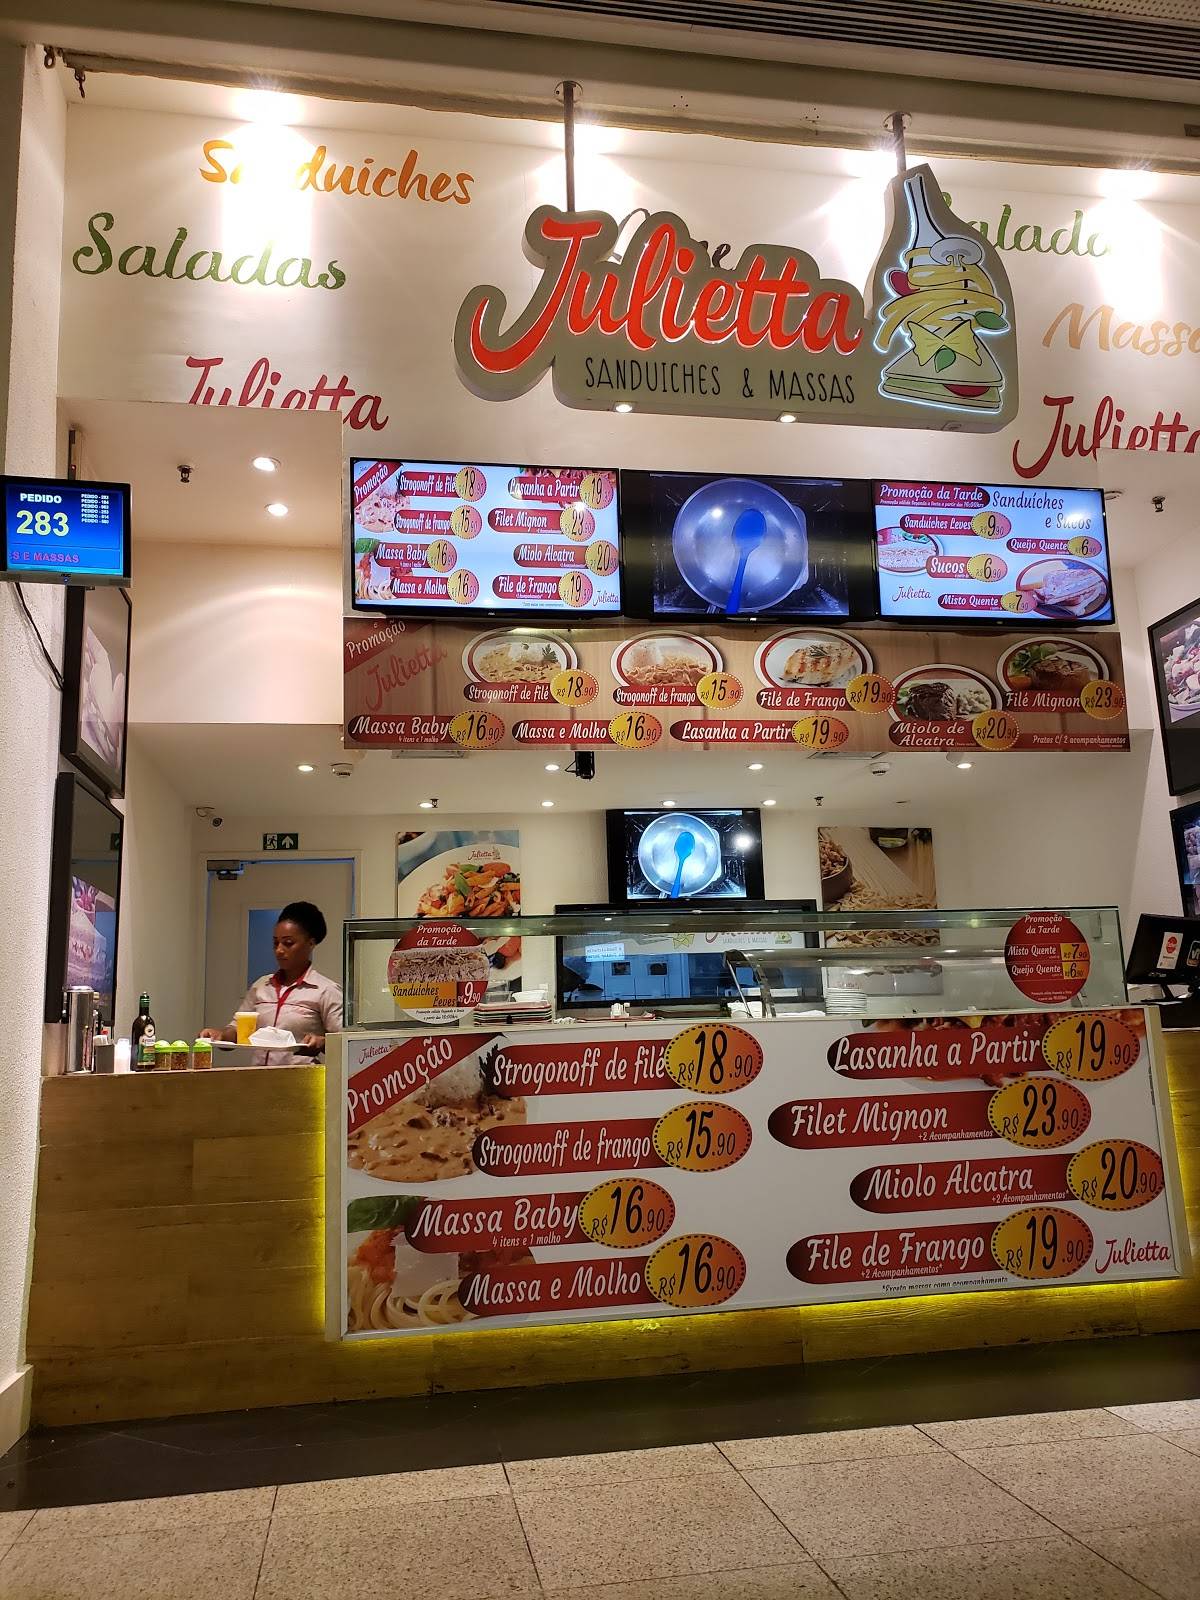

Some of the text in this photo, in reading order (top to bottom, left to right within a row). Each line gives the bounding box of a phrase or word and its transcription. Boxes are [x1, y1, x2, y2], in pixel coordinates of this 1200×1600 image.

[199, 139, 475, 205] Sduiches
[72, 211, 347, 291] Saladas
[470, 216, 863, 375] Julietta
[585, 357, 856, 404] SANDUICHES & MASSAS
[354, 463, 389, 503] Promoção
[399, 475, 433, 496] Strogonoff
[436, 475, 443, 492] de
[509, 477, 580, 498] Lasanha a Partir
[880, 484, 983, 502] Promoção da Tarde
[20, 493, 62, 504] PEDIDO
[992, 490, 1065, 510] Sanduíches
[16, 510, 69, 537] 283
[395, 513, 425, 534] Strogonoff
[426, 514, 432, 529] de
[494, 510, 548, 532] Filet Mignon
[904, 515, 972, 530] Sanduíches Leves
[1045, 512, 1092, 530] e Sucos
[375, 543, 428, 566] Massa Baby
[517, 544, 575, 562] Miolo Alcatra
[1010, 538, 1068, 553] Queijo Quente
[34, 553, 79, 563] MASSAS
[930, 557, 965, 574] Sucos
[391, 577, 447, 595] Massa e Molho
[515, 575, 526, 593] de
[527, 577, 558, 598] Frango
[892, 585, 932, 602] Julietta
[592, 590, 619, 607] Julietta
[940, 594, 999, 607] Misto Quente
[345, 618, 406, 660] Promoção
[468, 684, 549, 704] Strogonoff de filé
[615, 686, 696, 707] Strogonoff de frango
[759, 689, 846, 712] Filé de Frango
[1005, 691, 1081, 713] Filé Mignon
[352, 715, 450, 741] Massa Baby
[515, 721, 607, 739] Massa e Molho
[682, 721, 791, 741] Lasanha a Partir
[893, 721, 965, 734] Miolo de
[898, 735, 955, 747] Alcatra
[1032, 734, 1054, 745] Pratos
[1069, 735, 1127, 746] acompanhamentos
[416, 924, 462, 935] Promoção
[1024, 914, 1063, 924] Promoção
[1026, 925, 1060, 934] da Tarde
[417, 936, 458, 946] da Tarde
[1007, 945, 1057, 957] Misto Quente
[1011, 964, 1061, 976] Queijo Quente
[432, 996, 456, 1008] Leves
[358, 1046, 389, 1065] Julietta
[833, 1029, 1041, 1072] Lasanha a Partir
[1055, 1019, 1131, 1073] R$19.90
[676, 1029, 754, 1086] R$18.90
[347, 1036, 453, 1124] Promoção
[493, 1045, 665, 1095] Strogonoff de filé
[791, 1101, 948, 1141] Filet Mignon
[1001, 1083, 1080, 1138] R$23.90
[665, 1109, 737, 1163] R$15.90
[928, 1129, 994, 1143] Acompanhamentos
[479, 1127, 651, 1175] Strogonoff de frango
[864, 1161, 1034, 1201] Miolo Alcatra
[1080, 1145, 1158, 1201] R$20.90
[411, 1193, 580, 1239] Massa Baby
[590, 1185, 666, 1238] R$16.90
[492, 1232, 561, 1248] 4 itens e 1 molho
[806, 1230, 985, 1271] File de Frango
[1005, 1213, 1085, 1271] R$19.90
[1095, 1237, 1171, 1275] Julietta
[658, 1241, 737, 1299] R$16.90
[464, 1261, 641, 1307] Massa e Molho
